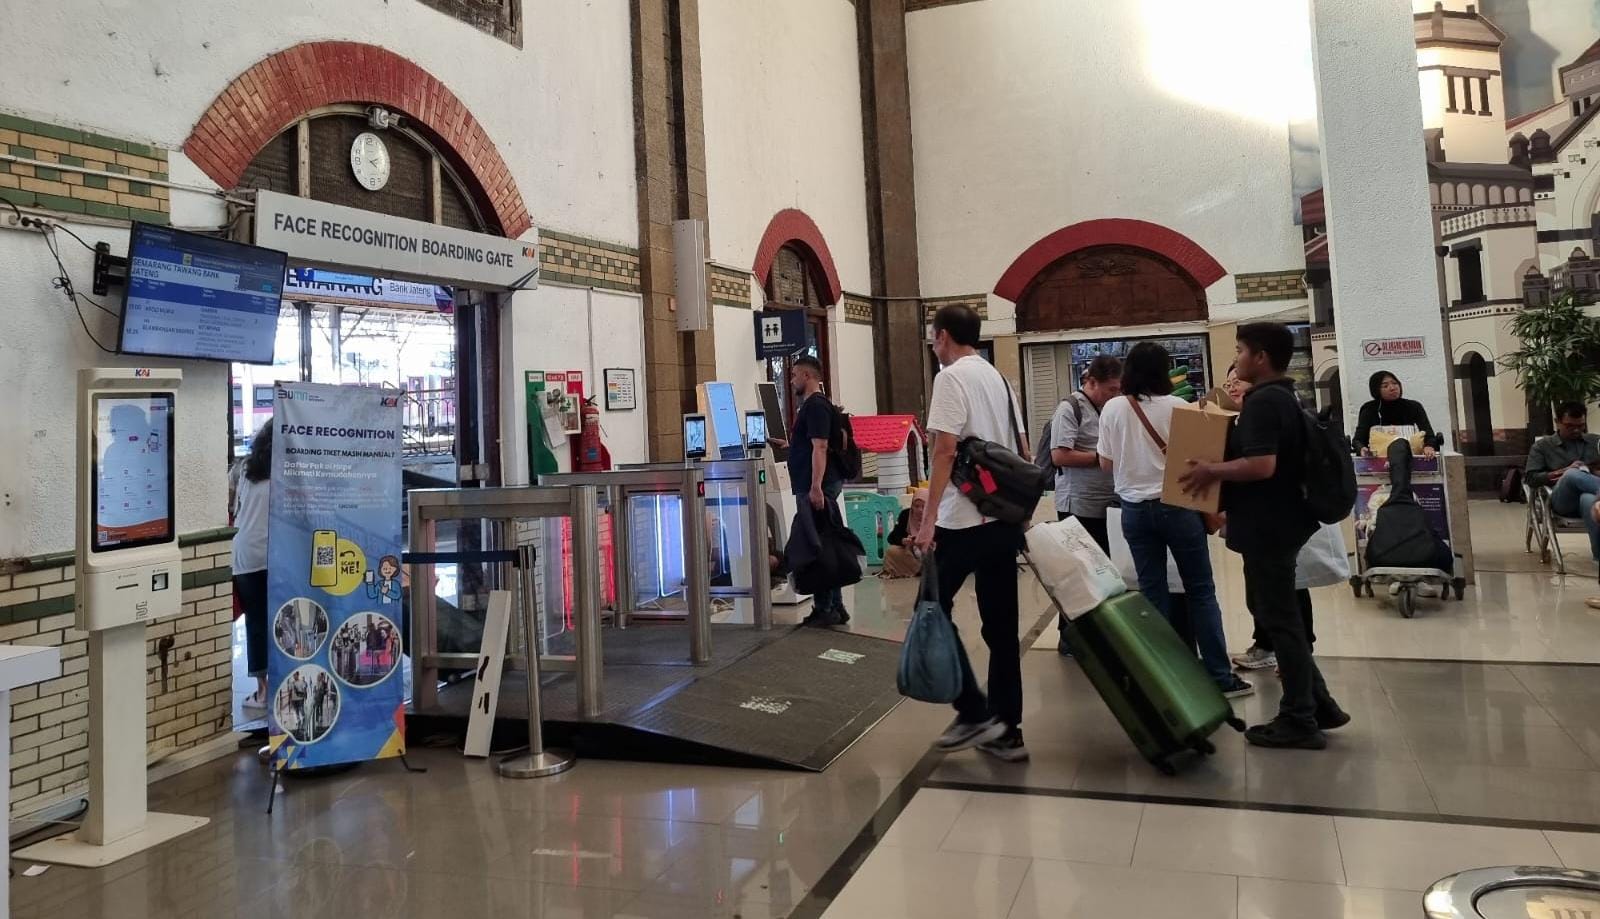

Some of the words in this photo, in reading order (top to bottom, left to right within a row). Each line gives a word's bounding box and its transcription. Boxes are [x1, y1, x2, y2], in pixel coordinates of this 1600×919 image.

[274, 213, 317, 236] FACE
[321, 221, 418, 253] RECOGNITION
[422, 238, 483, 263] BOARDING
[486, 249, 514, 268] GATE
[132, 267, 159, 278] JATENG
[133, 257, 171, 272] SEMARANG
[174, 265, 202, 278] TAWANG
[390, 282, 408, 294] Bank
[409, 284, 432, 297] Jateng
[281, 424, 314, 436] FACE
[315, 426, 395, 440] RECOGNITION
[285, 447, 322, 456] BOARDING
[323, 448, 340, 457] TIKET
[341, 449, 362, 458] MASIH
[362, 450, 395, 459] MANUAL?
